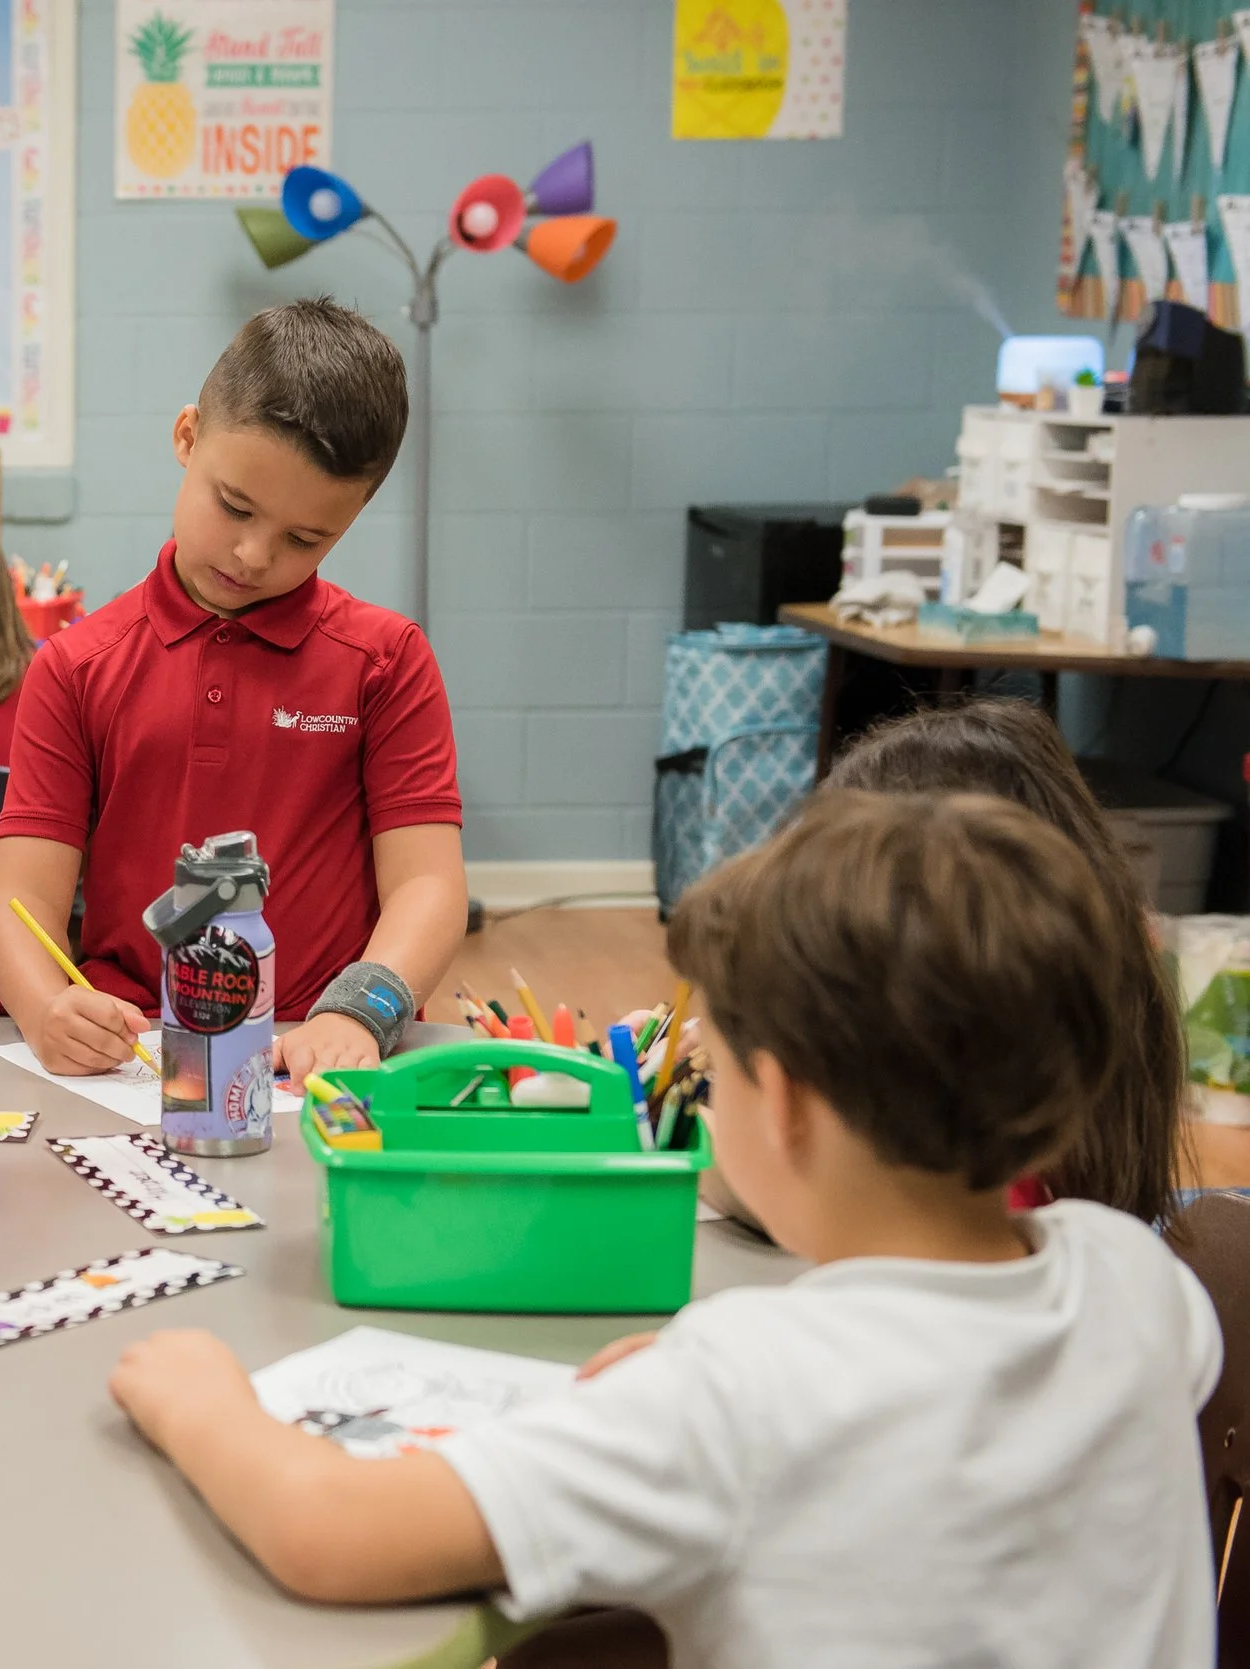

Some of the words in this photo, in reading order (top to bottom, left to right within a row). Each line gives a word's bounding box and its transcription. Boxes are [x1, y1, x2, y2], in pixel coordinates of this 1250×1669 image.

[202, 122, 321, 175] INSIDE
[299, 723, 346, 733] CHRISTIAN
[301, 715, 358, 725] LOWCOUNTRY
[173, 961, 207, 985] ABLE
[212, 970, 255, 991] ROCK
